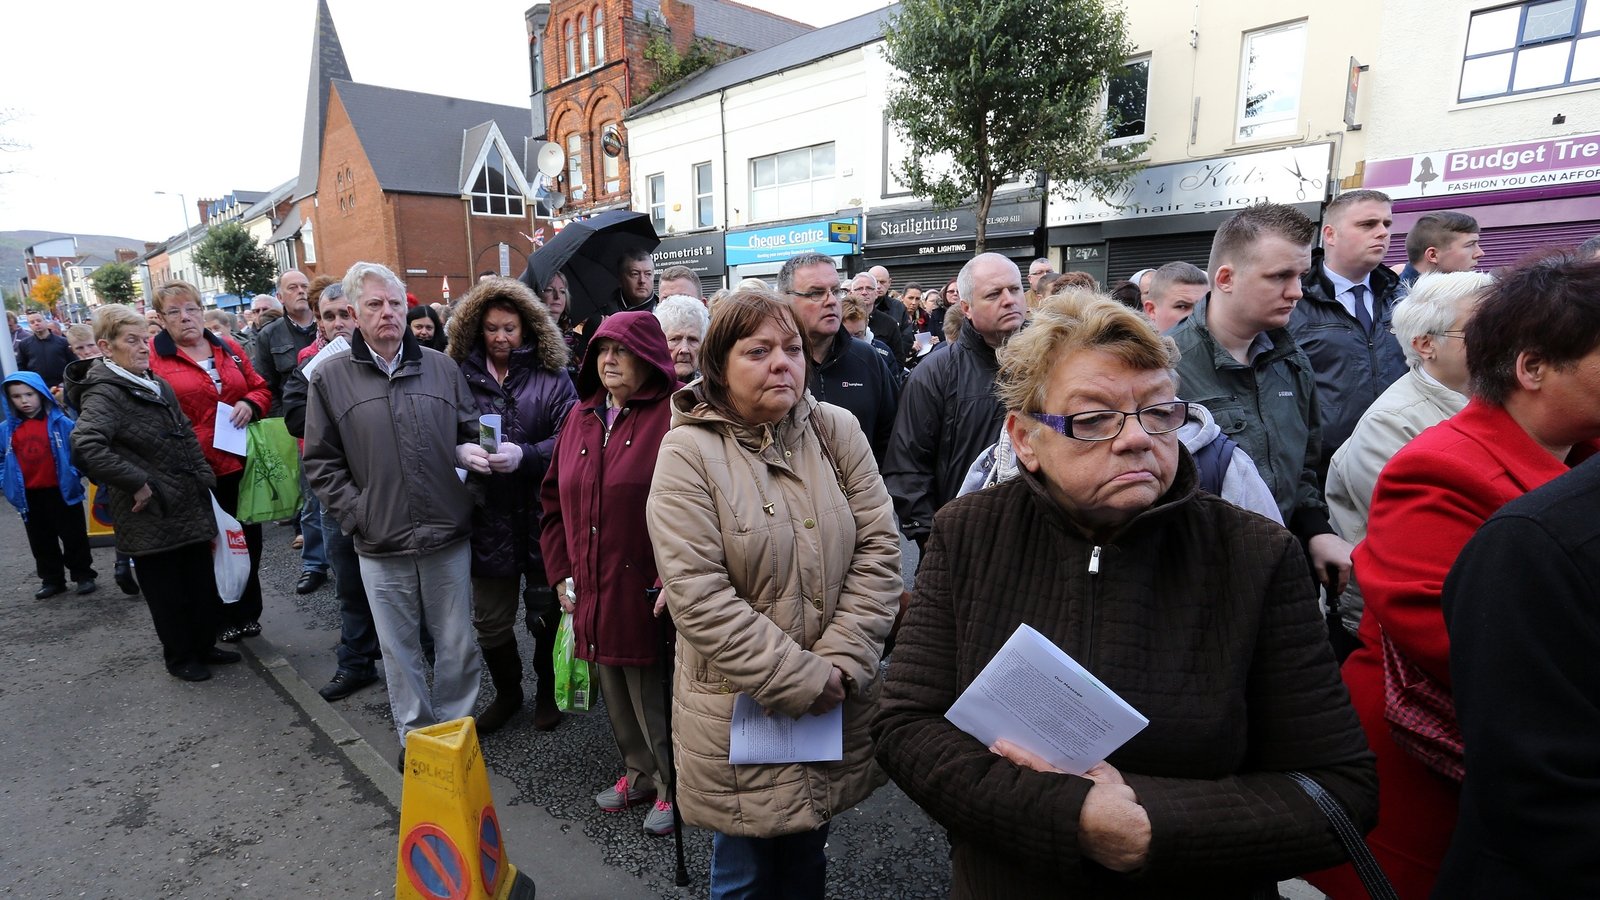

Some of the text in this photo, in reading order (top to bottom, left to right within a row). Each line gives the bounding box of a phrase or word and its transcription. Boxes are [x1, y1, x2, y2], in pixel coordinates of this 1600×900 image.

[1450, 140, 1600, 172] Budget Tre
[1447, 180, 1498, 192] FASHION
[1501, 176, 1527, 186] YOU
[1530, 173, 1557, 184] CAN
[1135, 202, 1185, 215] hair
[1194, 195, 1269, 209] salon
[880, 215, 958, 236] Starlighting
[985, 215, 1009, 225] EL:9059
[748, 233, 787, 249] Cheque
[789, 228, 824, 244] Centre
[918, 243, 967, 255] STAR LIGHTING
[1075, 248, 1099, 260] 257A
[410, 758, 455, 785] POLICE
